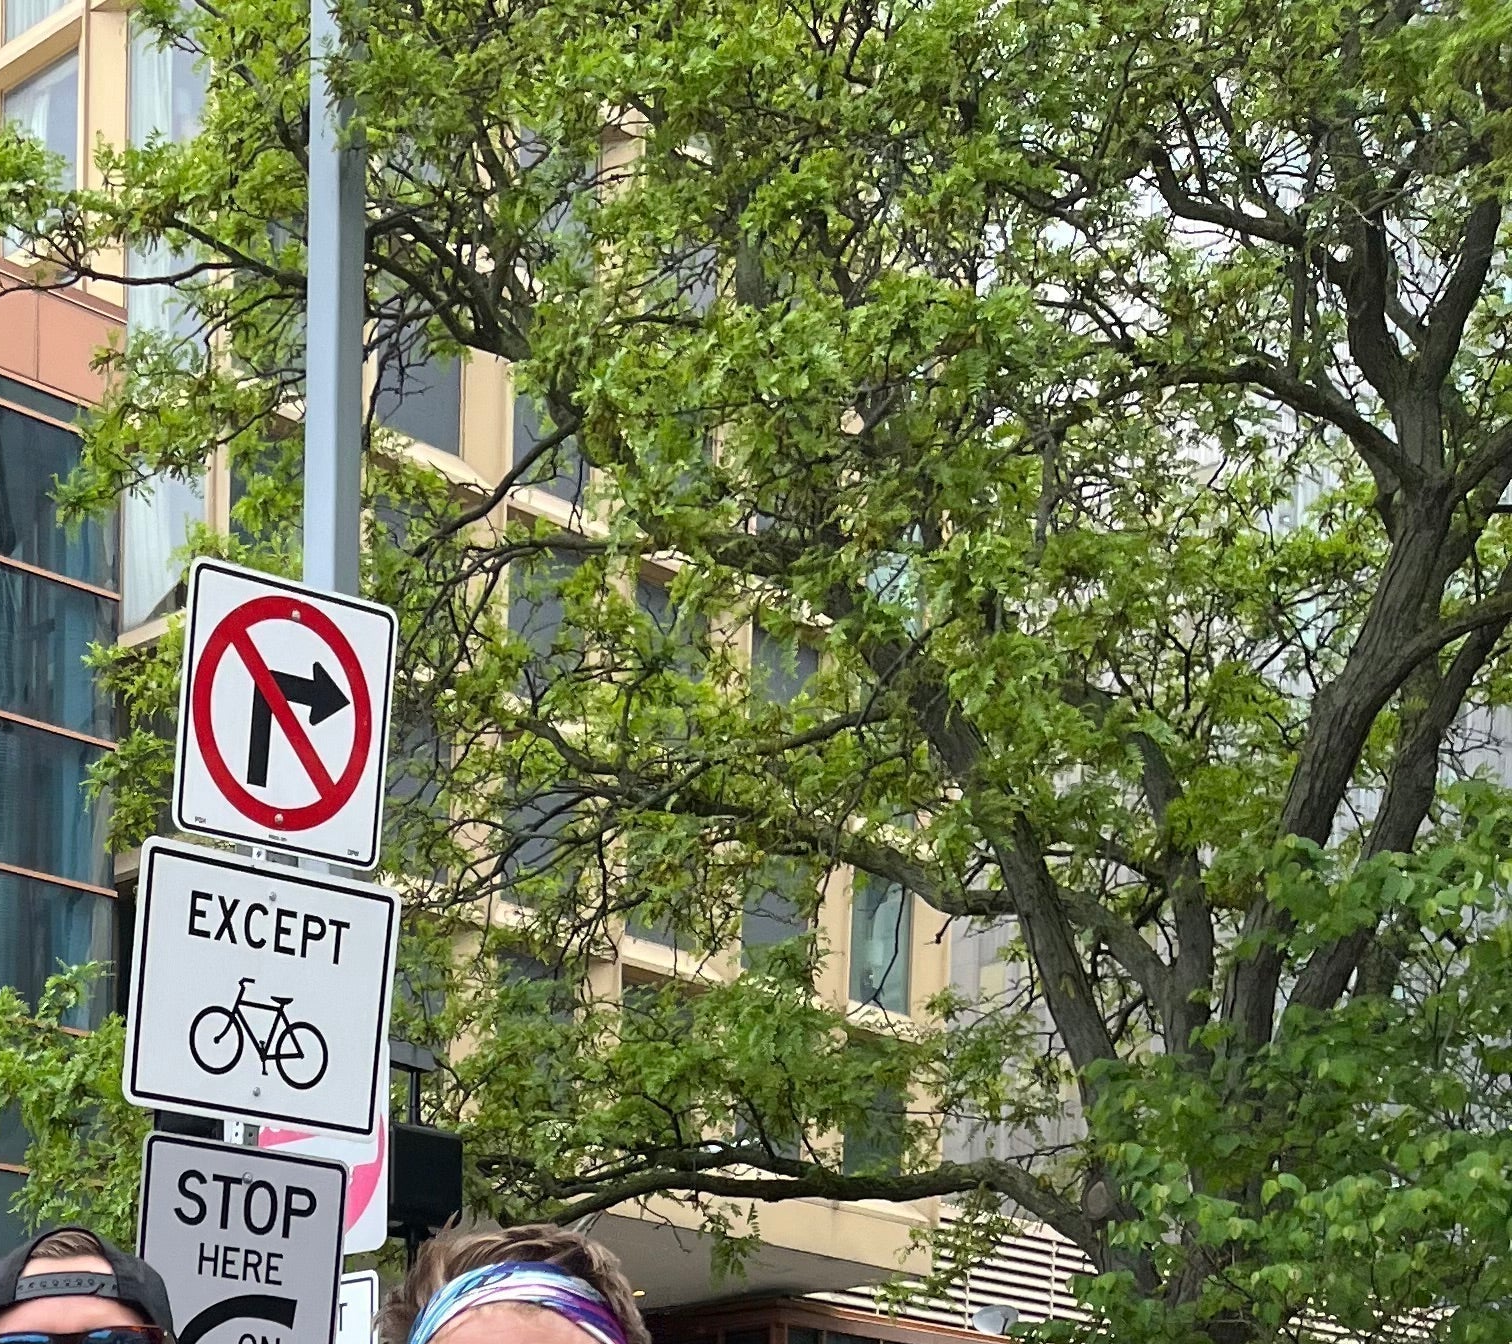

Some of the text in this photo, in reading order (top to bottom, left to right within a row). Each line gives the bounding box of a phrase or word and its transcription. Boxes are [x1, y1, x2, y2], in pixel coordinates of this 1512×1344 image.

[188, 890, 350, 965] EXCEPT
[174, 1169, 317, 1239] STOP
[197, 1242, 284, 1286] HERE
